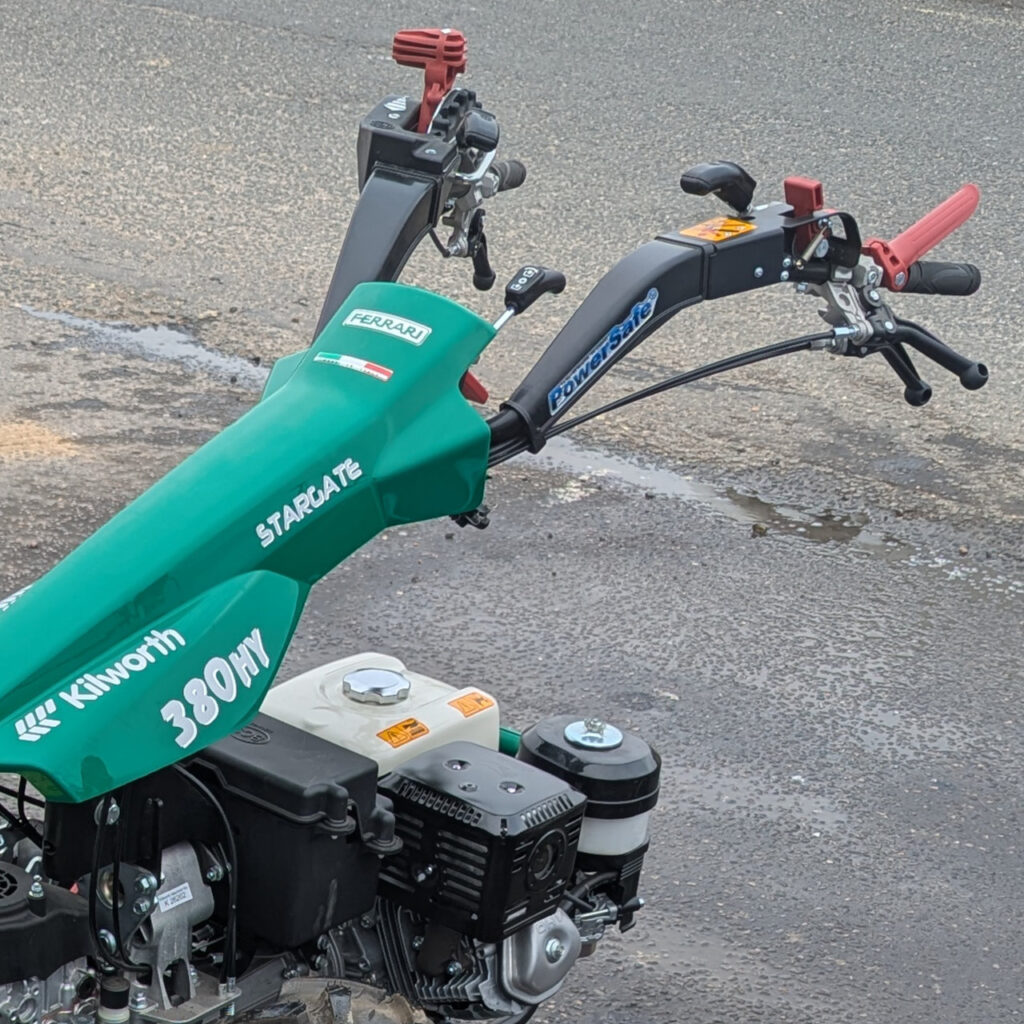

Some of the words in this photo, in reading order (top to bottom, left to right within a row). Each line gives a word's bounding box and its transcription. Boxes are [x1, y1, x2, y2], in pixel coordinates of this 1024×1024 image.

[350, 313, 424, 340] FERRARI
[255, 457, 363, 548] STARGATE
[58, 628, 186, 709] Kilworth
[160, 627, 269, 749] 380HY
